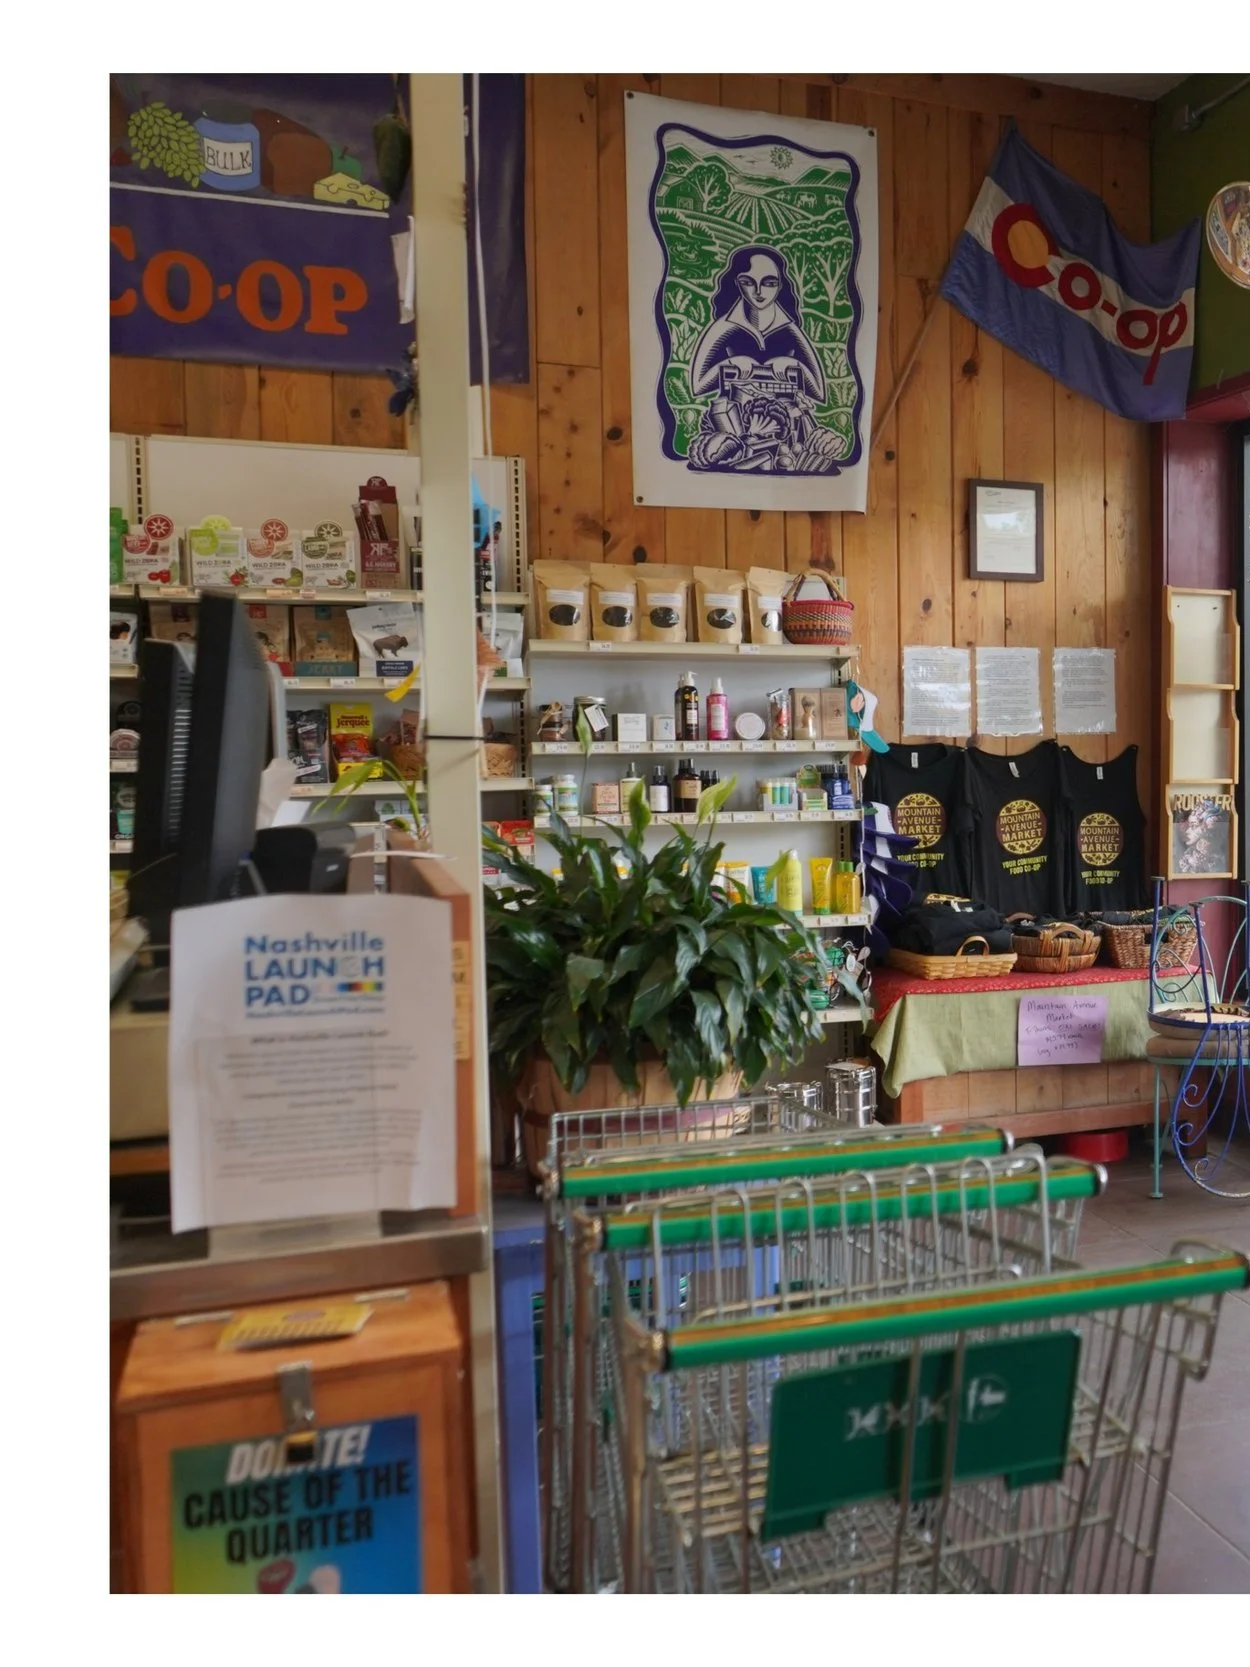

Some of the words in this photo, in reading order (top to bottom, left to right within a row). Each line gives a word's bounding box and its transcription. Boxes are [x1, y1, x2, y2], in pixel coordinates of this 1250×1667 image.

[205, 146, 253, 172] BULK
[897, 807, 941, 817] MOUNTAIN
[1000, 811, 1041, 825] MOUNTAIN
[898, 824, 941, 835] MARKET
[1002, 828, 1042, 842] MARKET
[1080, 827, 1120, 835] MOUNTAIN
[1081, 843, 1119, 852] MARKET
[1002, 860, 1017, 869] YOUR
[1017, 855, 1048, 866] COMMUNITY
[1010, 866, 1023, 875] FOOD
[245, 930, 385, 955] Nashville
[245, 955, 385, 982] LAUNCH
[245, 984, 312, 1007] PAD
[184, 1479, 292, 1531] CAUSE
[304, 1469, 342, 1510] OF
[354, 1459, 411, 1498] THE
[225, 1505, 375, 1566] QUARTER
